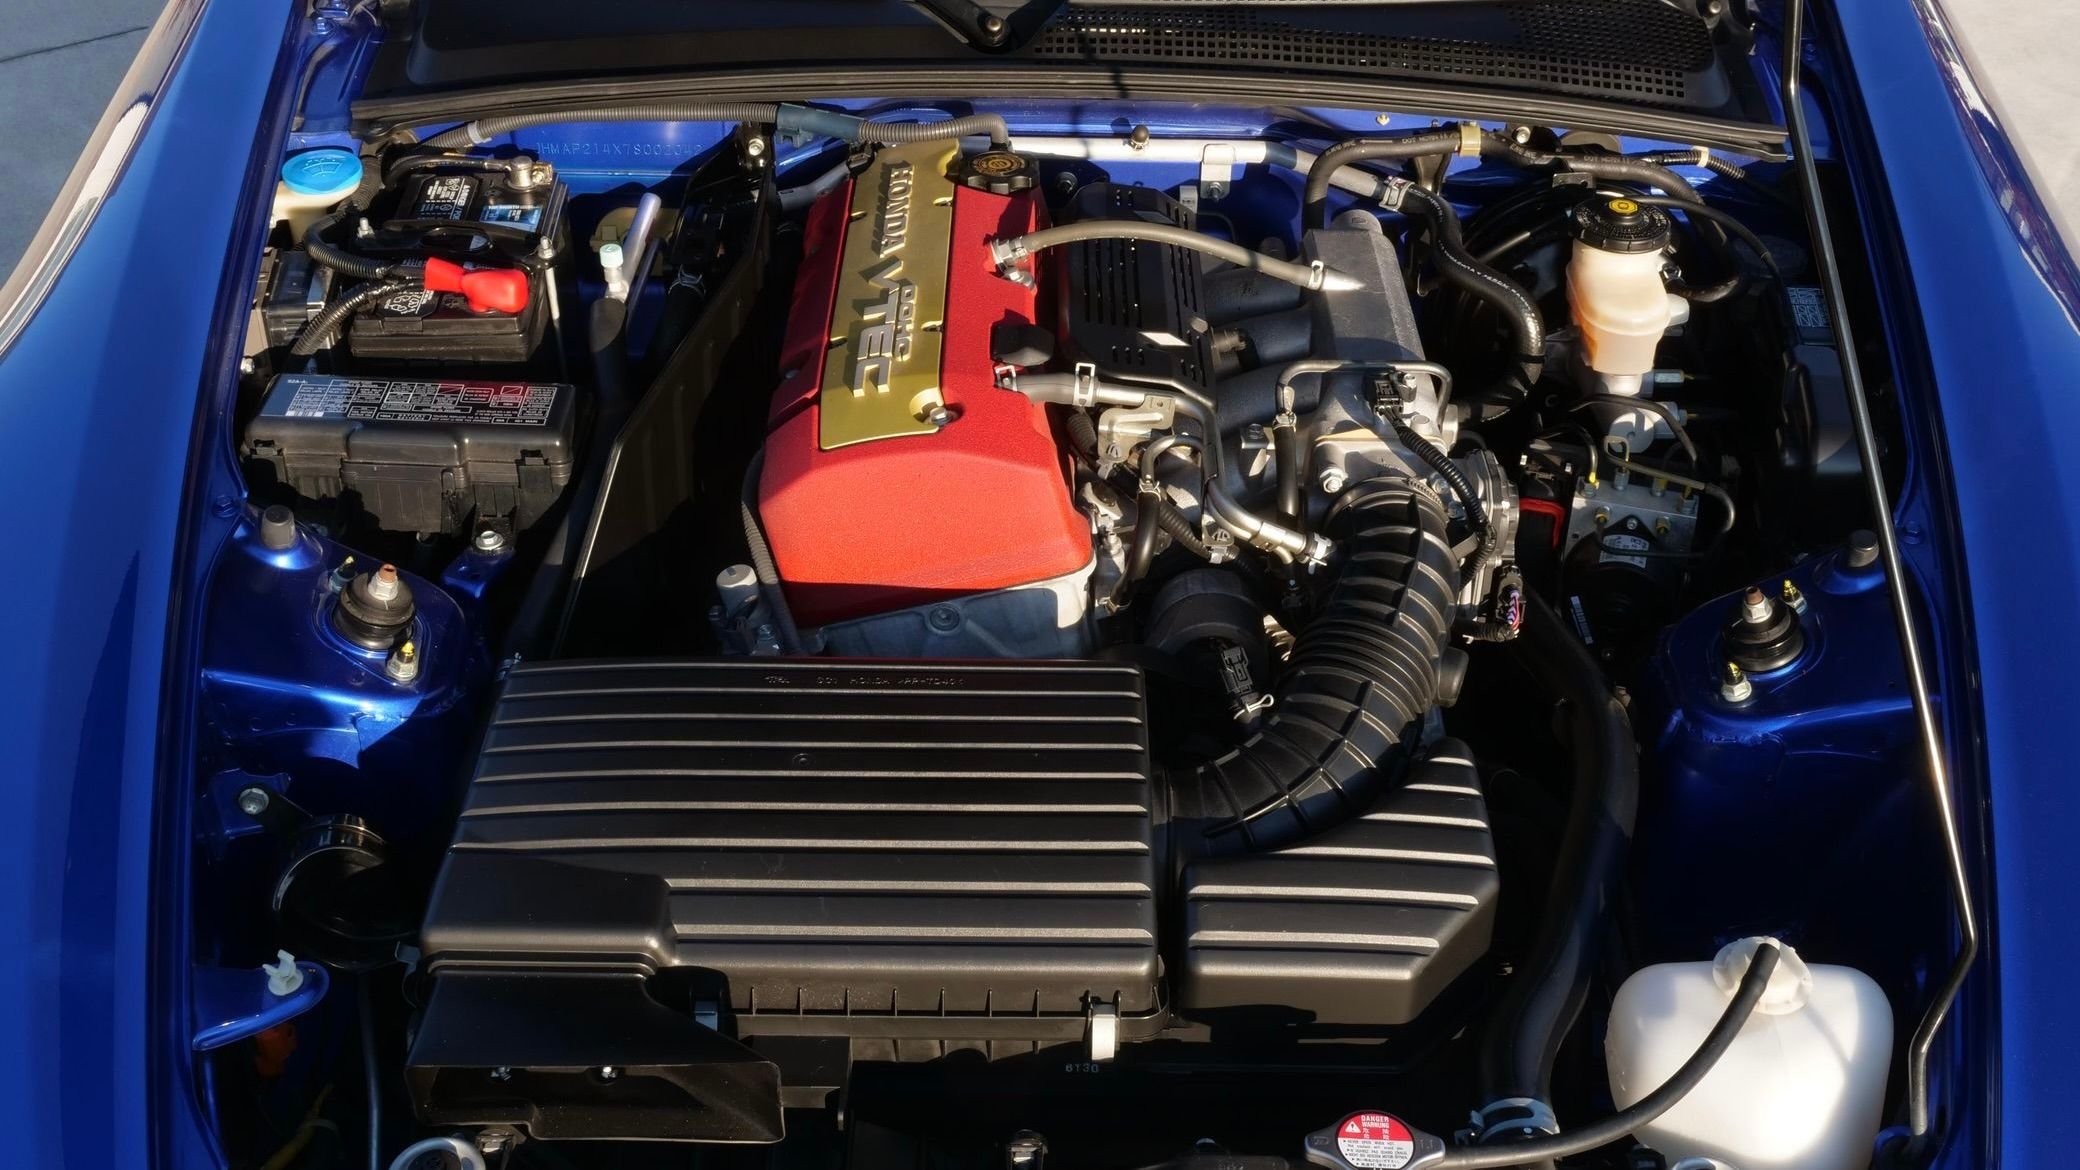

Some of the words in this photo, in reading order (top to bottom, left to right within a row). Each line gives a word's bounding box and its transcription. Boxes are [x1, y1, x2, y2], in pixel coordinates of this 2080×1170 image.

[880, 165, 915, 259] HONDA
[853, 260, 904, 399] VTEC
[894, 285, 919, 362] DOHC
